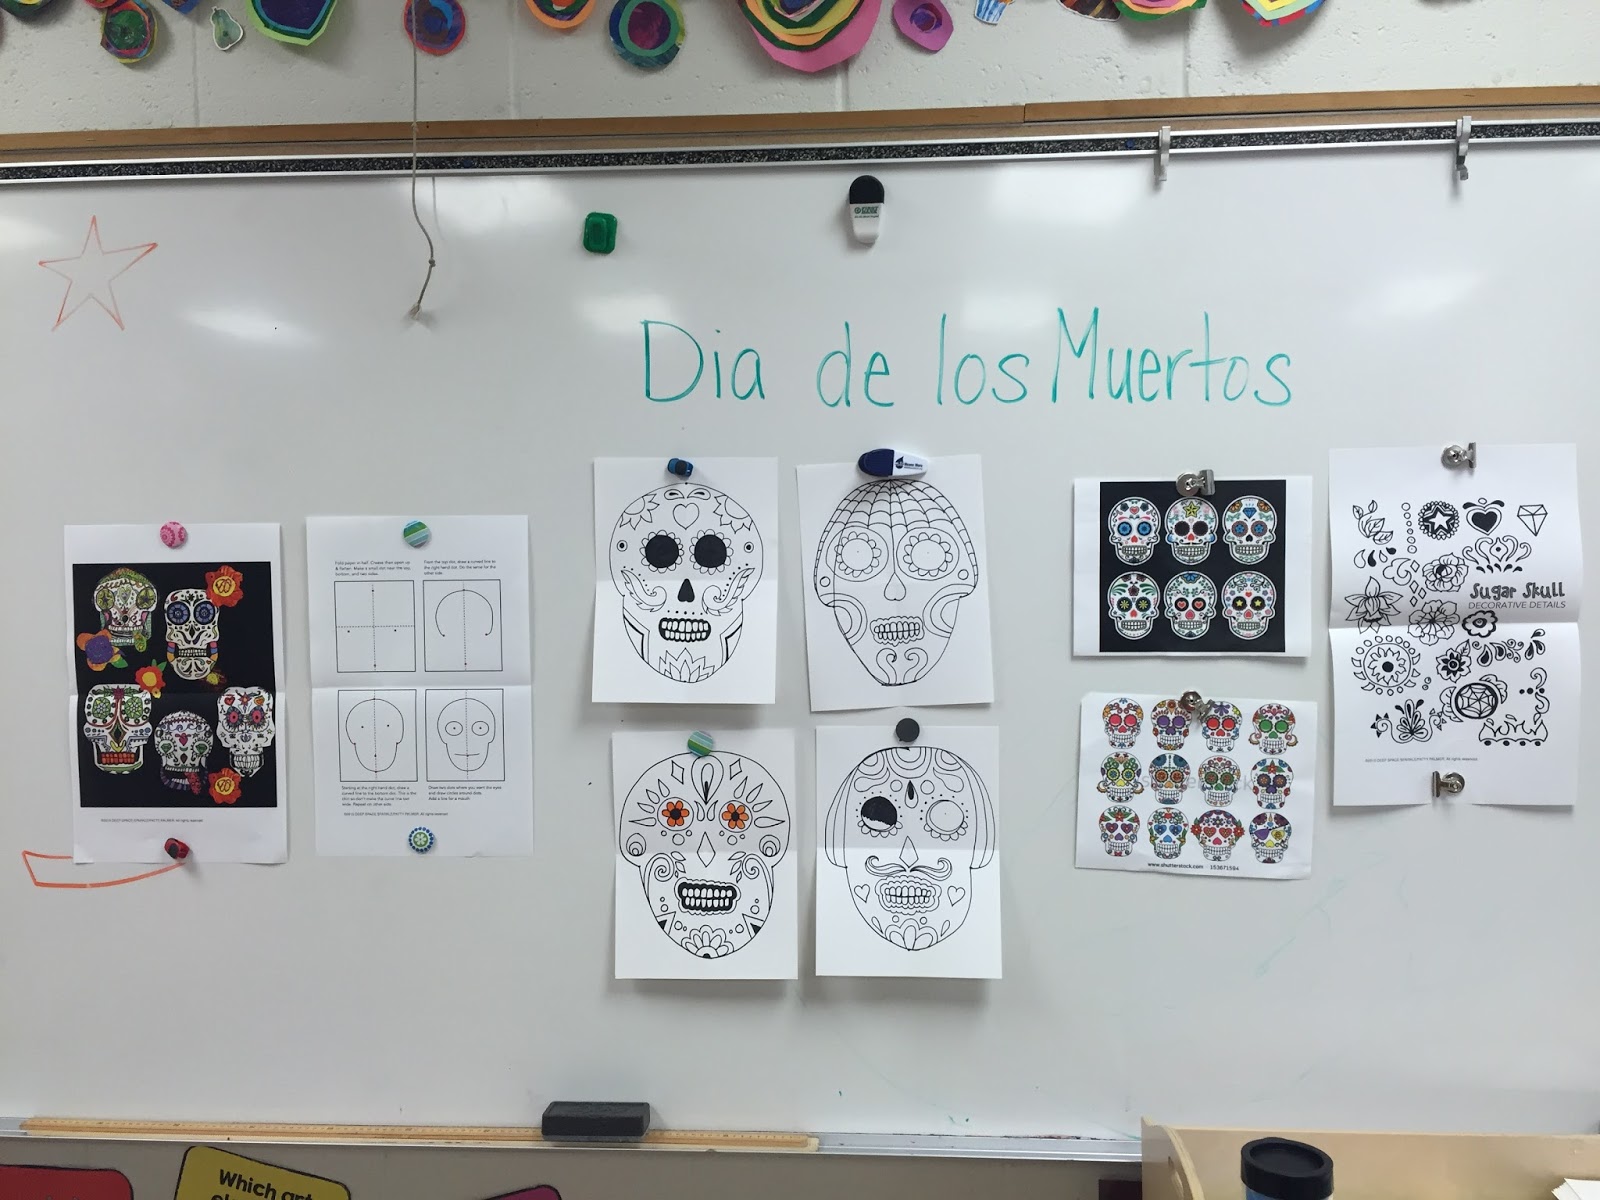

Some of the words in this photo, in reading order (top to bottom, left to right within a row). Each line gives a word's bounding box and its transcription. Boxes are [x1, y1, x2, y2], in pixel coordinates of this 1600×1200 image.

[640, 319, 766, 403] Dia
[816, 320, 895, 408] de
[937, 312, 1030, 406] los
[1051, 307, 1293, 406] Muertos
[1470, 582, 1517, 601] Sugar
[1522, 581, 1566, 599] Skull
[1468, 601, 1527, 609] DECORATIVE
[219, 1169, 277, 1200] Which
